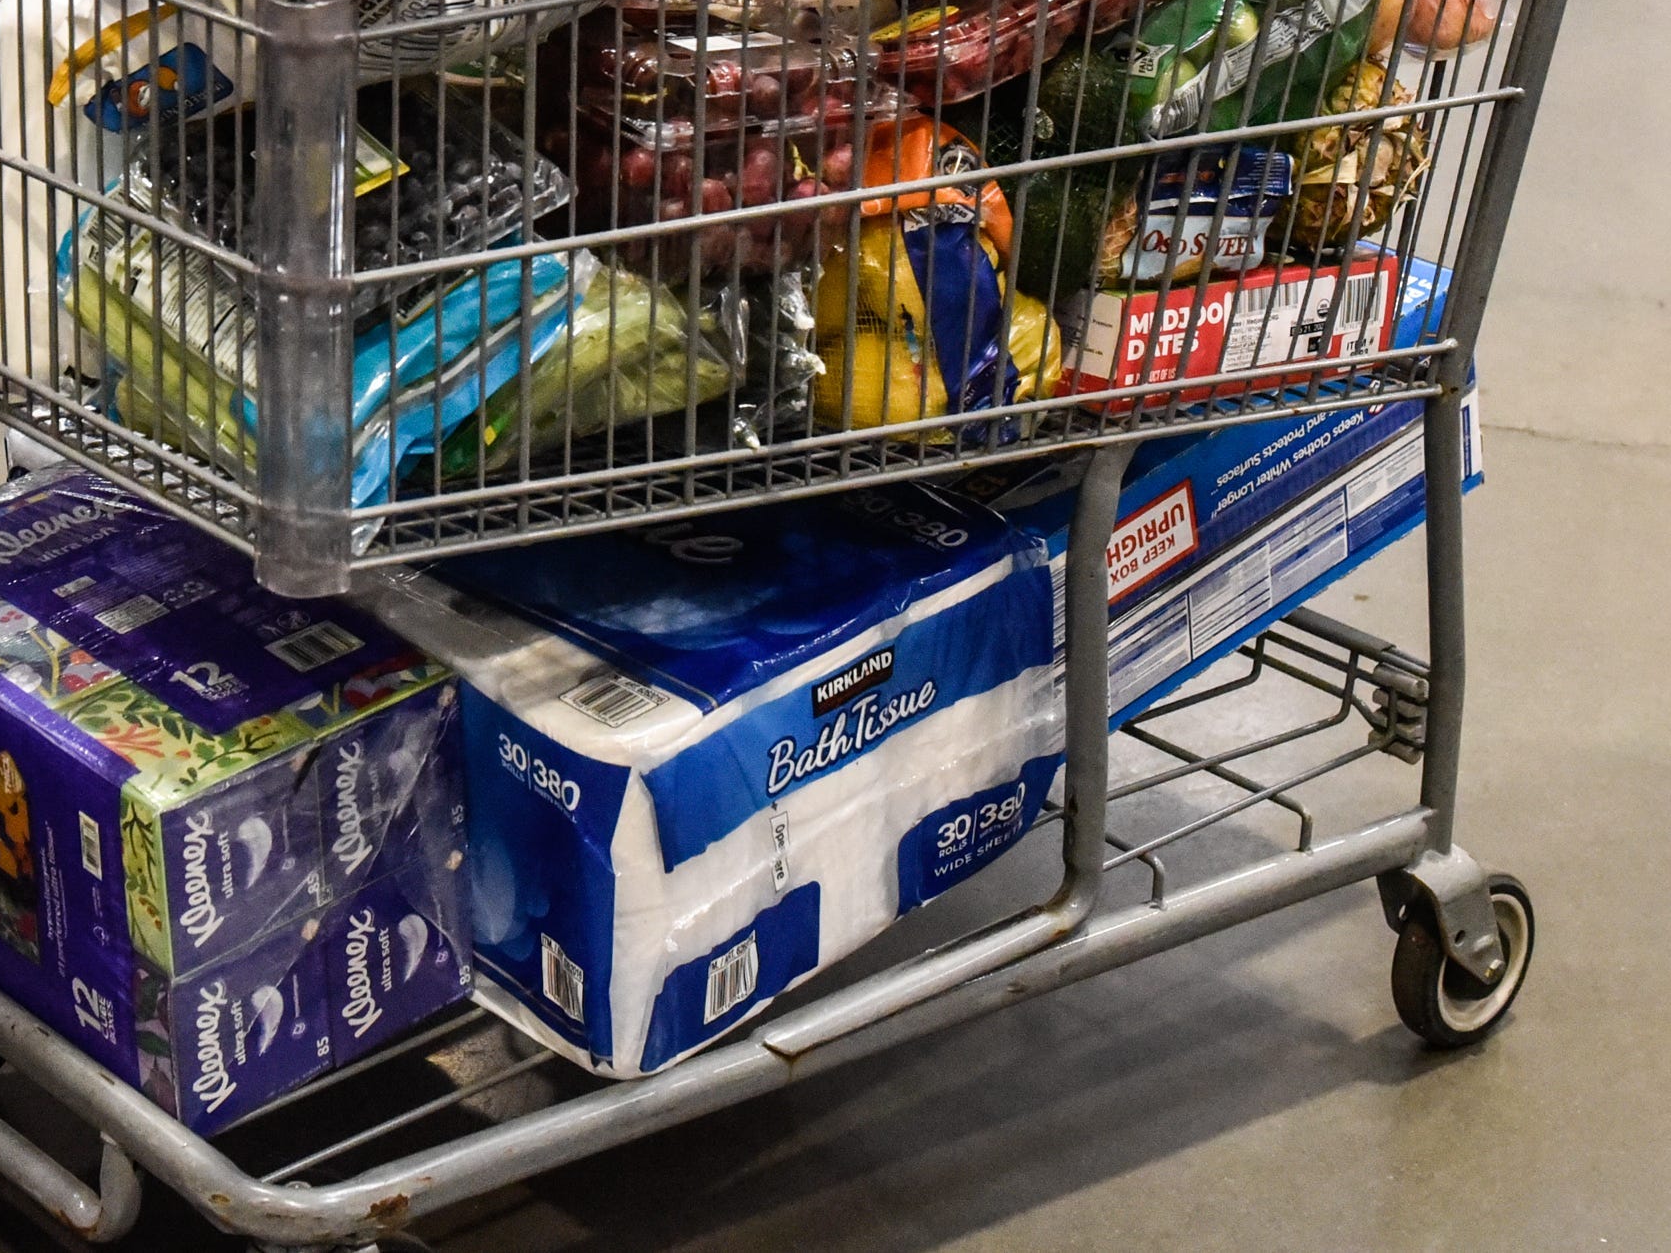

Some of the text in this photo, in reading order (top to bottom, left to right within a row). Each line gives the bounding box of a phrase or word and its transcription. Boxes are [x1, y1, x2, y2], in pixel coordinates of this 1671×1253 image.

[1346, 339, 1368, 351] ITM
[1216, 411, 1329, 486] and Protects Surfaces
[1293, 432, 1332, 463] Clothes
[1334, 410, 1364, 438] Keeps
[1256, 455, 1292, 485] Whiter
[82, 525, 121, 543] soft
[1106, 503, 1186, 568] UPRIGH
[1110, 533, 1176, 586] KEEP BOX
[168, 660, 235, 697] 12
[816, 650, 894, 703] KIRKLAND
[767, 680, 937, 794] Bath Tissue
[497, 732, 581, 812] 30 380
[331, 740, 373, 876] Kleenex
[936, 782, 1026, 849] 30 380
[217, 829, 234, 899] ultra soft
[933, 852, 973, 877] WIDE
[938, 837, 968, 858] ROLLS
[179, 809, 225, 948] Kleenex
[341, 905, 384, 1039] Kleenex
[377, 926, 393, 993] ultra soft
[459, 964, 472, 987] 85
[72, 976, 104, 1033] 12
[230, 999, 247, 1066] ultra soft
[192, 976, 238, 1114] Kleenex
[316, 1035, 330, 1058] 85
